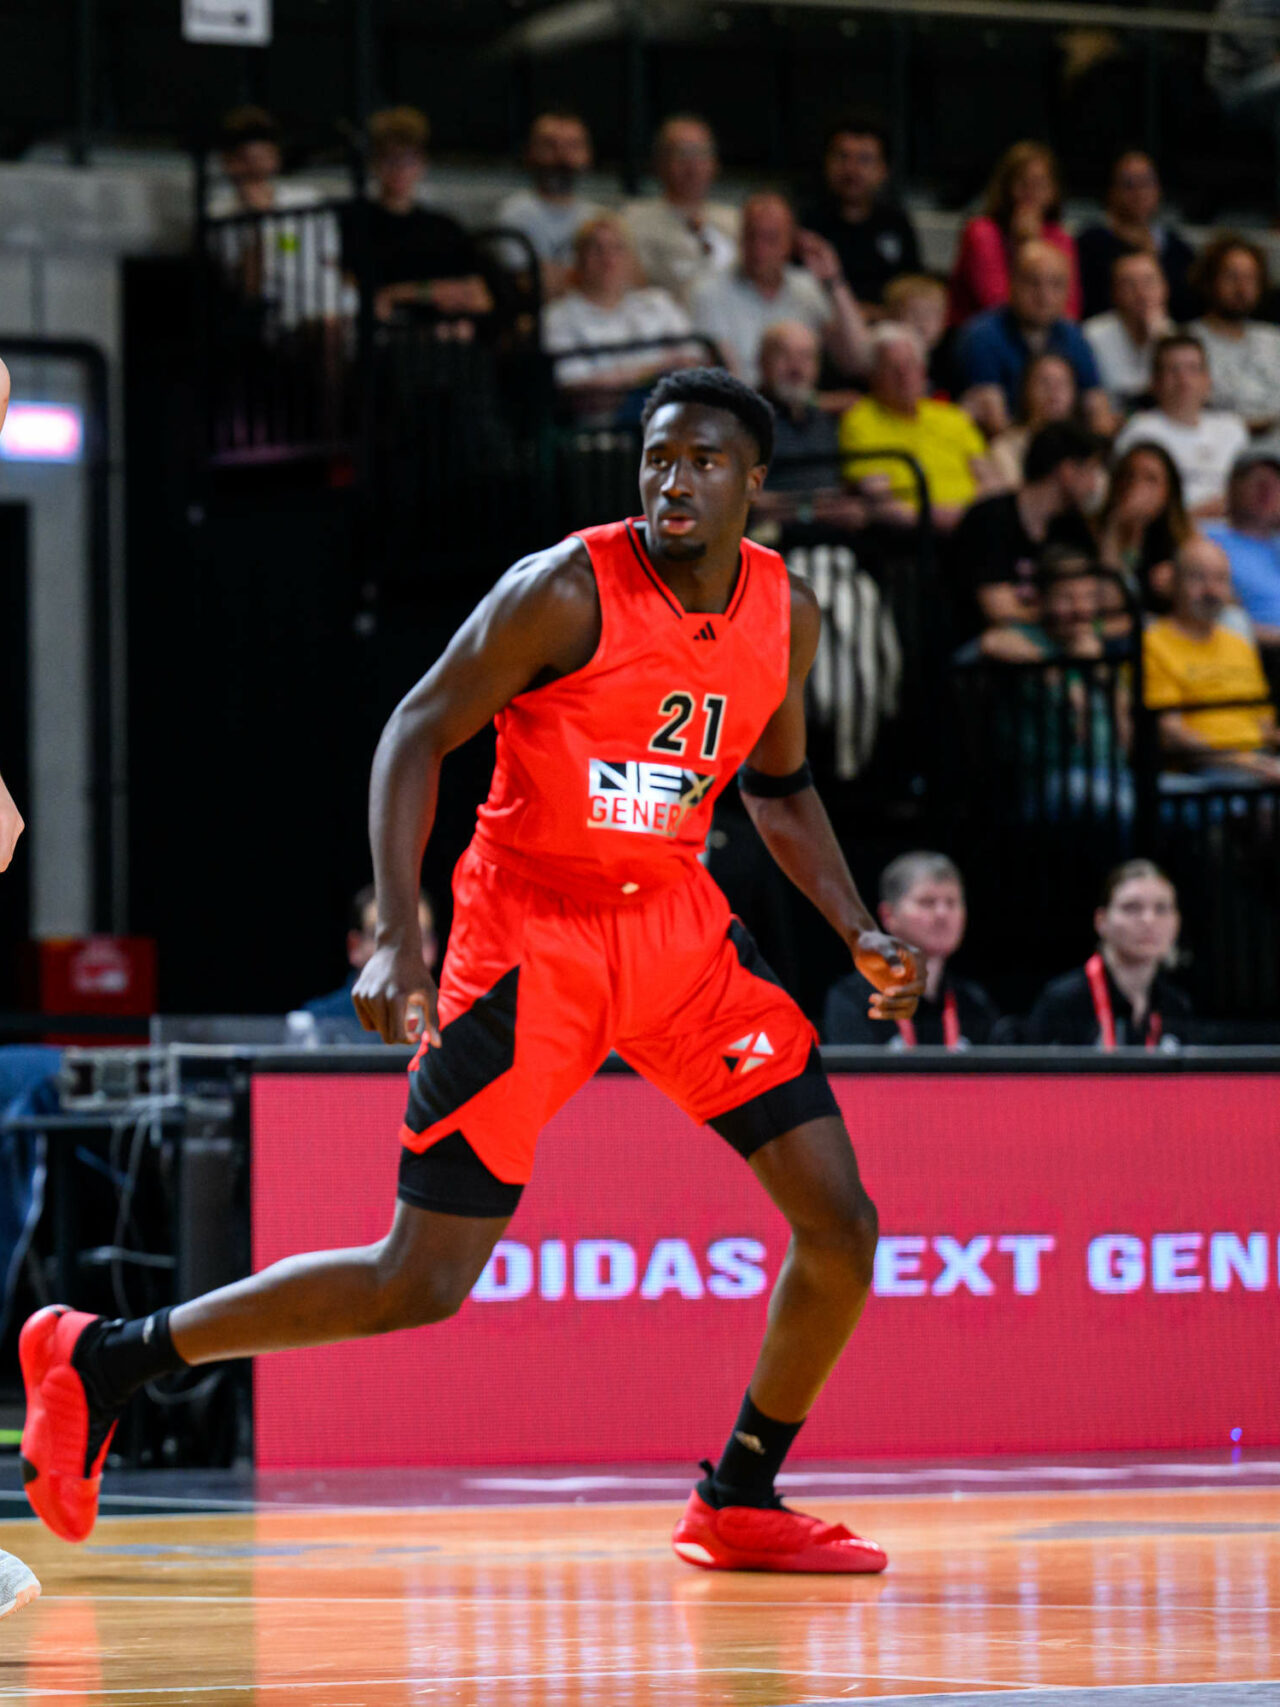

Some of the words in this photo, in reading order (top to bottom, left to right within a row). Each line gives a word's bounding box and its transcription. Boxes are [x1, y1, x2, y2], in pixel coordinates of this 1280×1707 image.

[648, 690, 727, 761] 21
[588, 758, 717, 809] NEX
[589, 795, 686, 835] GENER
[470, 1237, 768, 1302] DIDAS
[872, 1234, 1057, 1298] EXT
[1086, 1231, 1280, 1295] GEN
